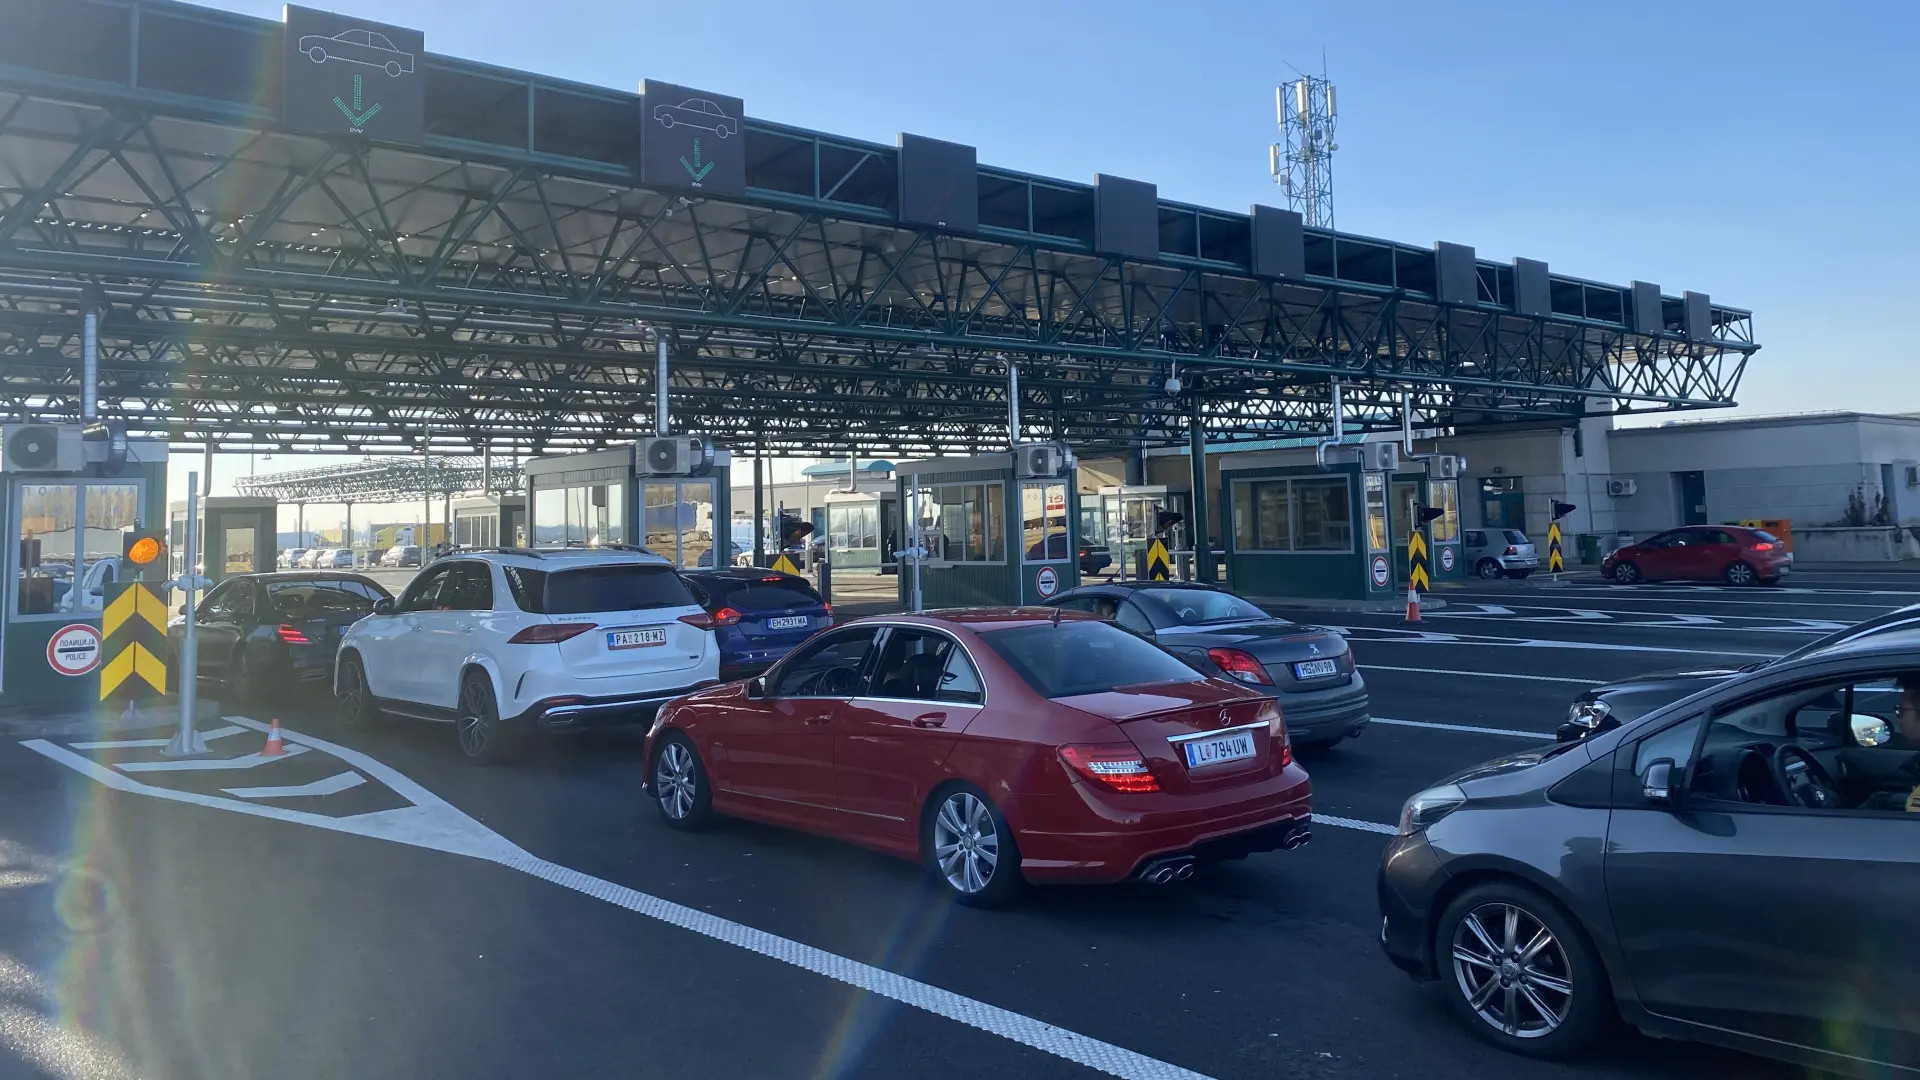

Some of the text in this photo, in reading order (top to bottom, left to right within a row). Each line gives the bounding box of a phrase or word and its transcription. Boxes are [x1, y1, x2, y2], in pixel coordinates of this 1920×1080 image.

[616, 634, 628, 645] PA
[65, 652, 87, 661] POLICE
[1198, 745, 1206, 761] L
